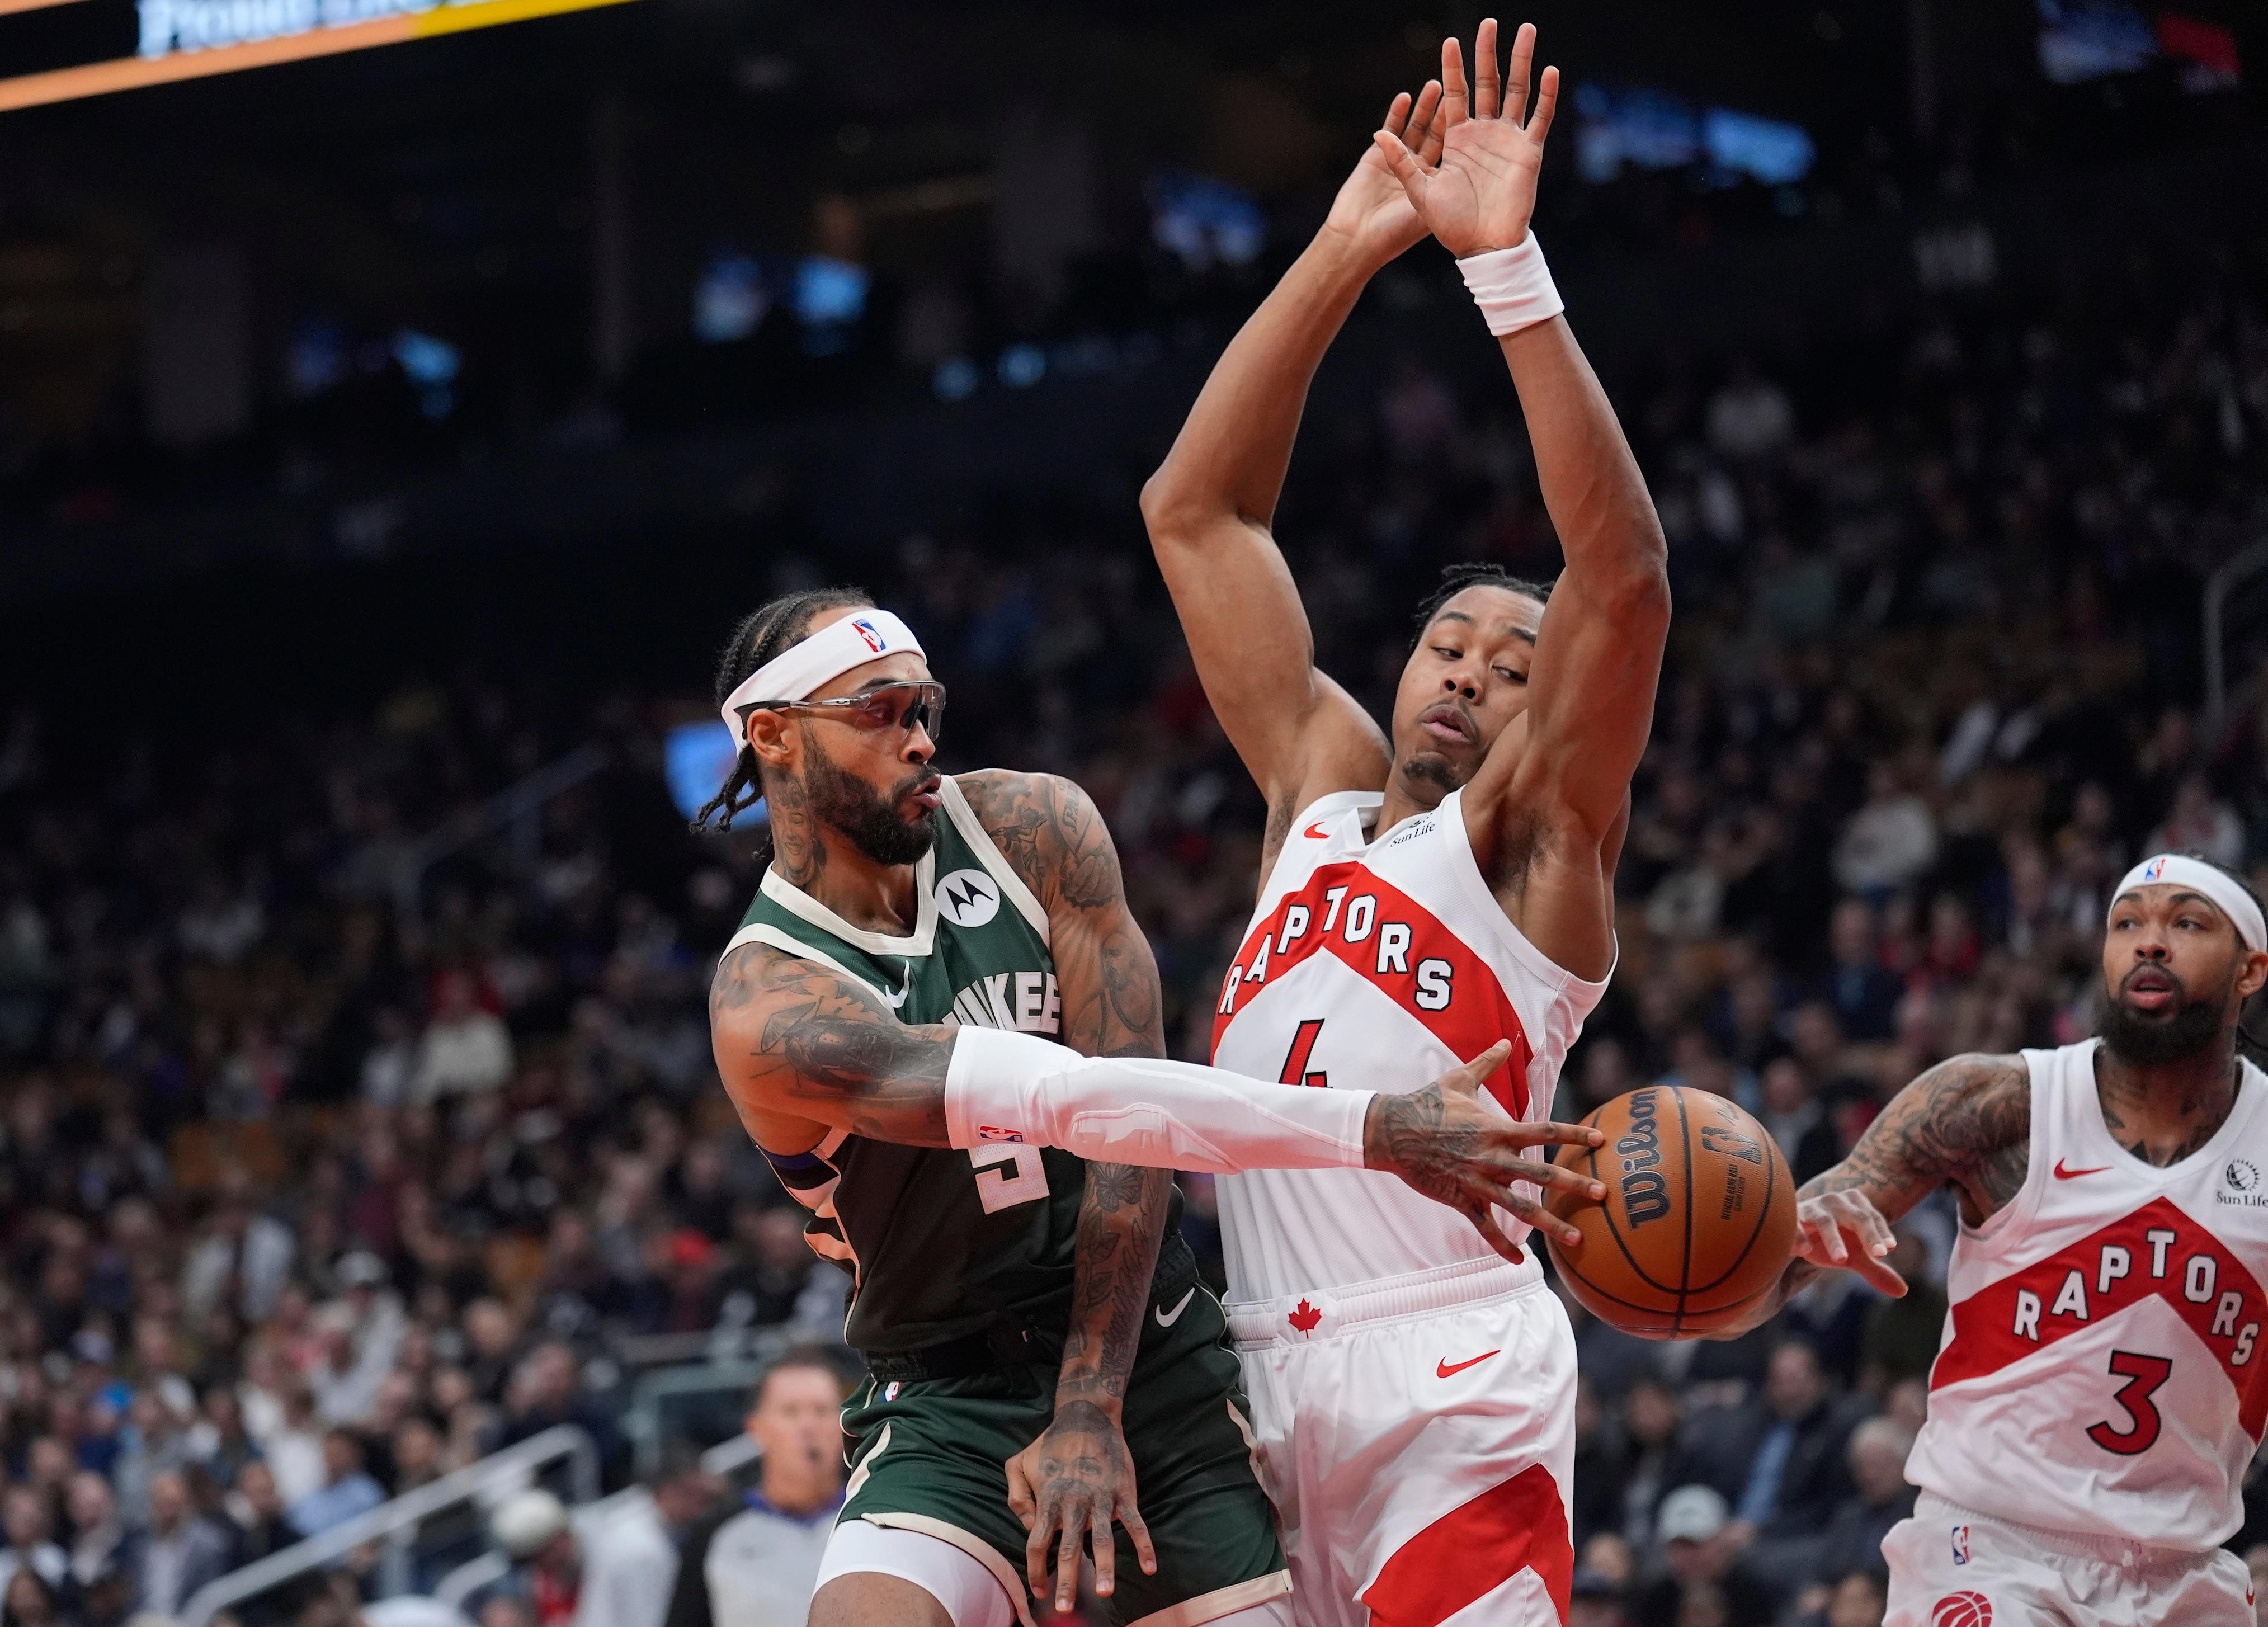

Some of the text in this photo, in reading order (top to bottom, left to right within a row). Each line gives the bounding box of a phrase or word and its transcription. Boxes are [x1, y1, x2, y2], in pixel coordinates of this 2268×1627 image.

[1390, 821, 1436, 847] Sun Life
[1218, 885, 1454, 1015] RAPTORS
[1615, 1088, 1671, 1230] Wilson
[2216, 1190, 2268, 1208] Sun Life
[2013, 1229, 2260, 1366] RAPTORS
[2086, 1350, 2173, 1455] 3
